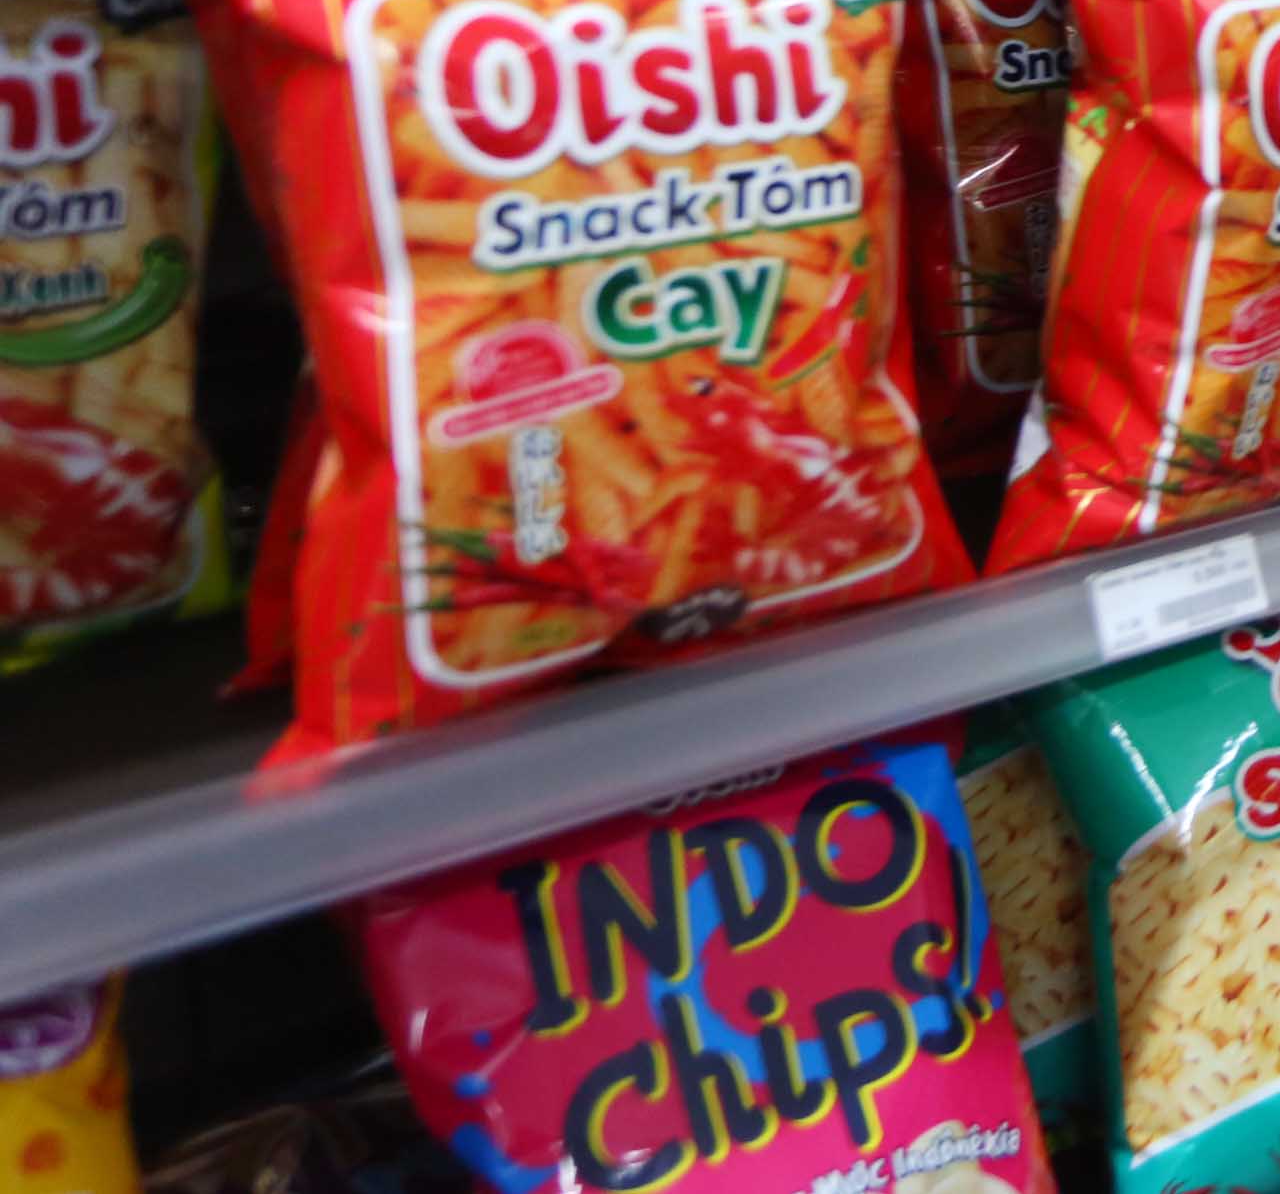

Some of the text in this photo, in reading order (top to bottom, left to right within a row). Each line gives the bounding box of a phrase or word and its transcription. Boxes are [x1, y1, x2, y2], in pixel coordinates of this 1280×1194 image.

[1000, 42, 1074, 89] Sna
[489, 177, 698, 256] Snack
[590, 258, 776, 355] Cay
[500, 779, 927, 1038] INDO
[563, 844, 992, 1194] Chips!
